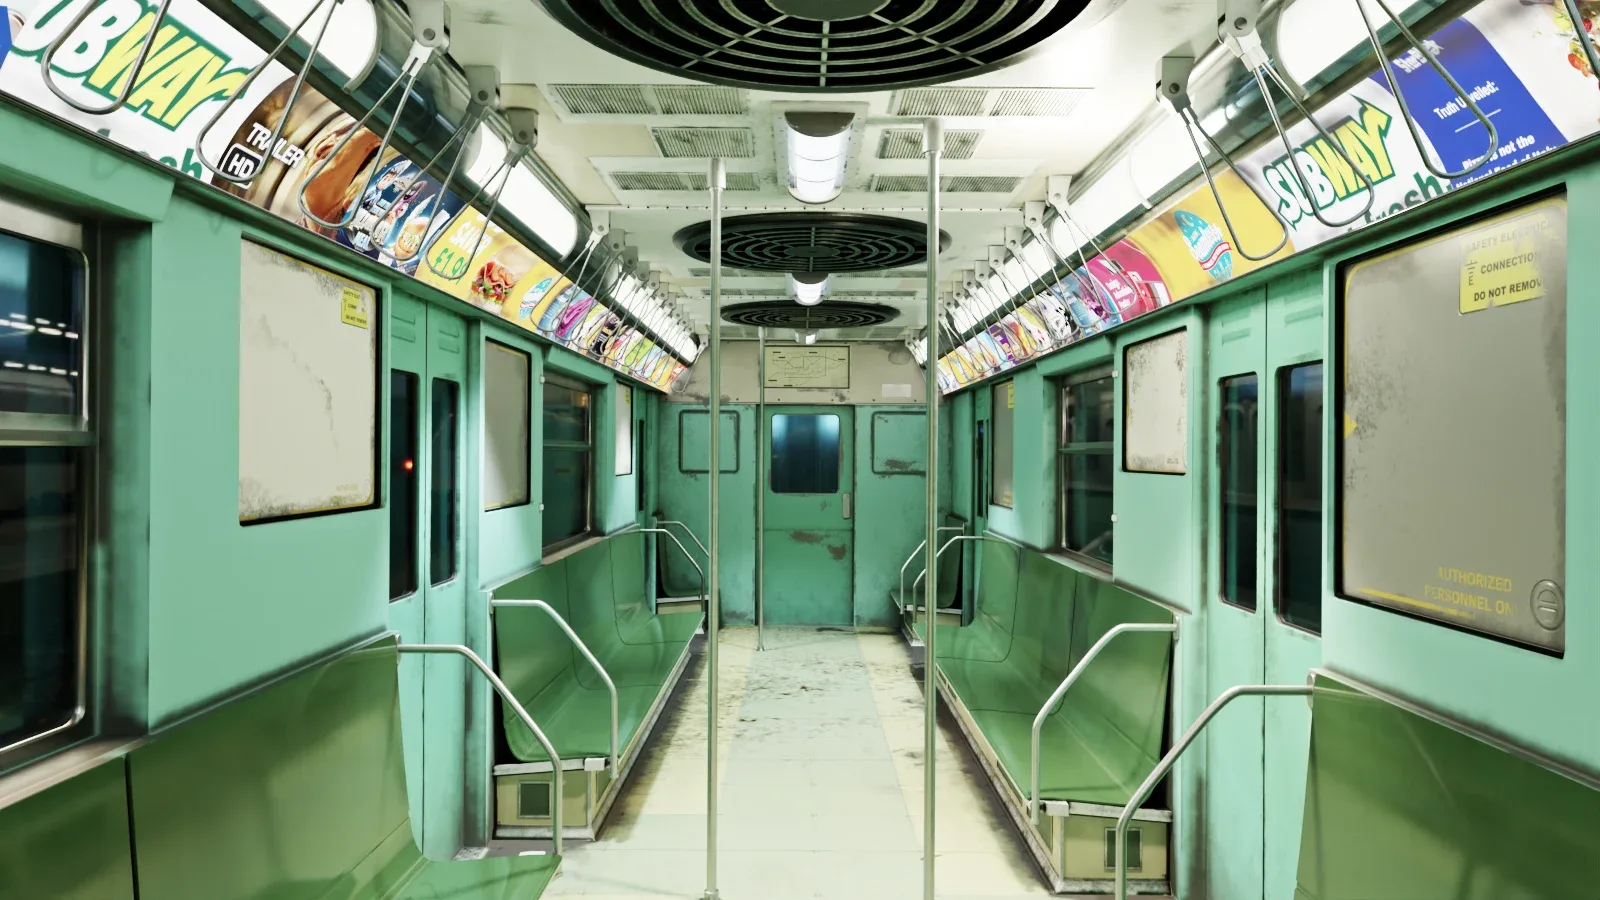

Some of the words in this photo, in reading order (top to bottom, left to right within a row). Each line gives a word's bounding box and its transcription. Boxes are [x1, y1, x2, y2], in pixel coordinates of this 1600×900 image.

[1433, 101, 1460, 120] Truth
[1454, 80, 1500, 109] Uveiled:
[1498, 140, 1517, 157] not
[1515, 134, 1536, 150] the
[228, 151, 255, 178] HD
[1262, 95, 1396, 231] SUBWAY
[1474, 291, 1486, 302] DO
[1488, 286, 1507, 298] NOT
[1509, 278, 1543, 294] REMOV
[1437, 567, 1512, 592] AUTHORIZED
[1424, 585, 1492, 612] PERSONNEL
